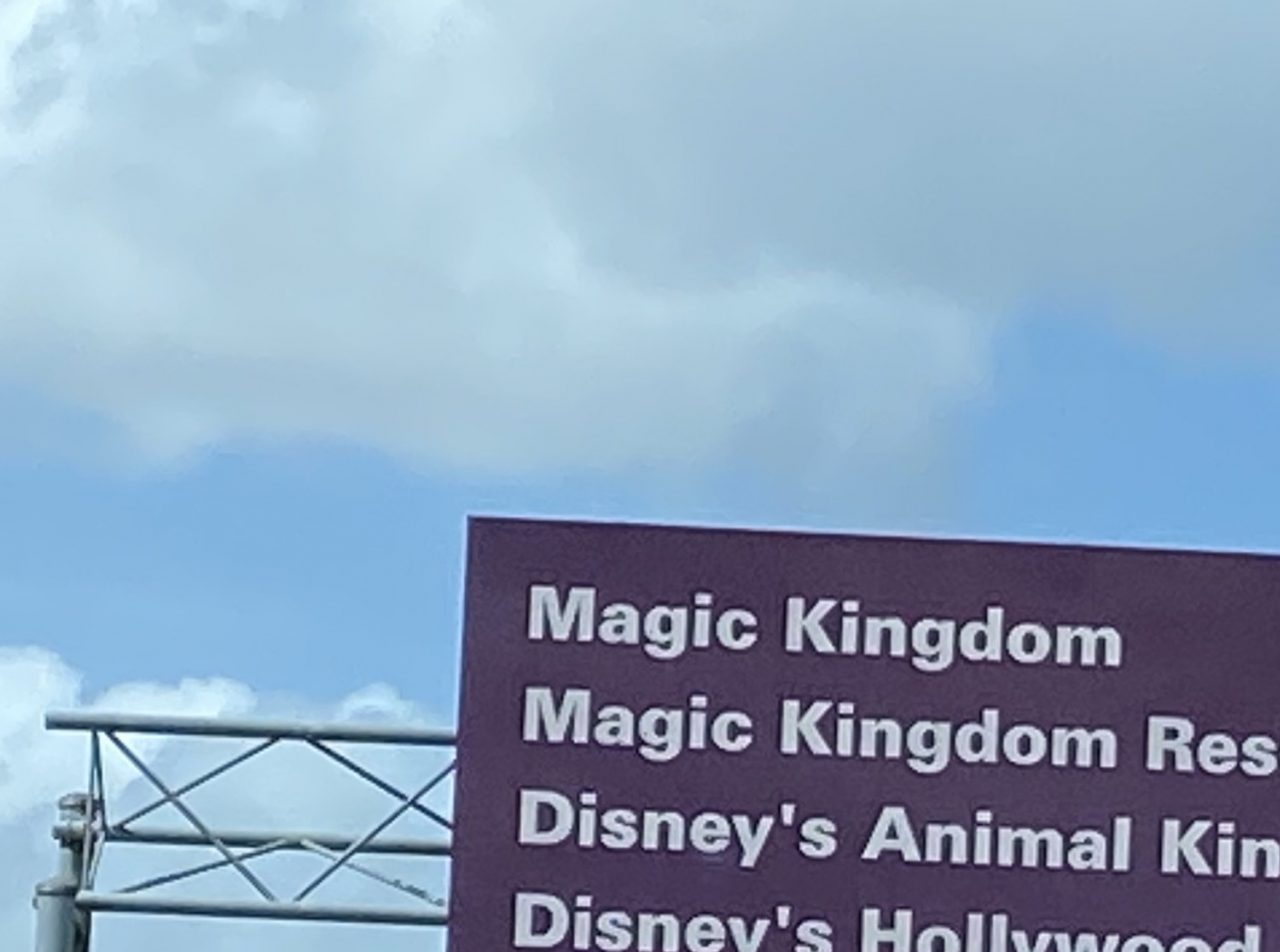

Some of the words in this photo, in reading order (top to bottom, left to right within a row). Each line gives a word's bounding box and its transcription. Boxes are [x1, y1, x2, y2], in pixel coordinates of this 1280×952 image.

[528, 585, 758, 660] Magic
[785, 596, 1122, 672] Kingdom
[523, 686, 753, 762] Magic
[780, 698, 1118, 774] Kingdom
[518, 788, 838, 868] Disney's
[860, 805, 1132, 872] Animal
